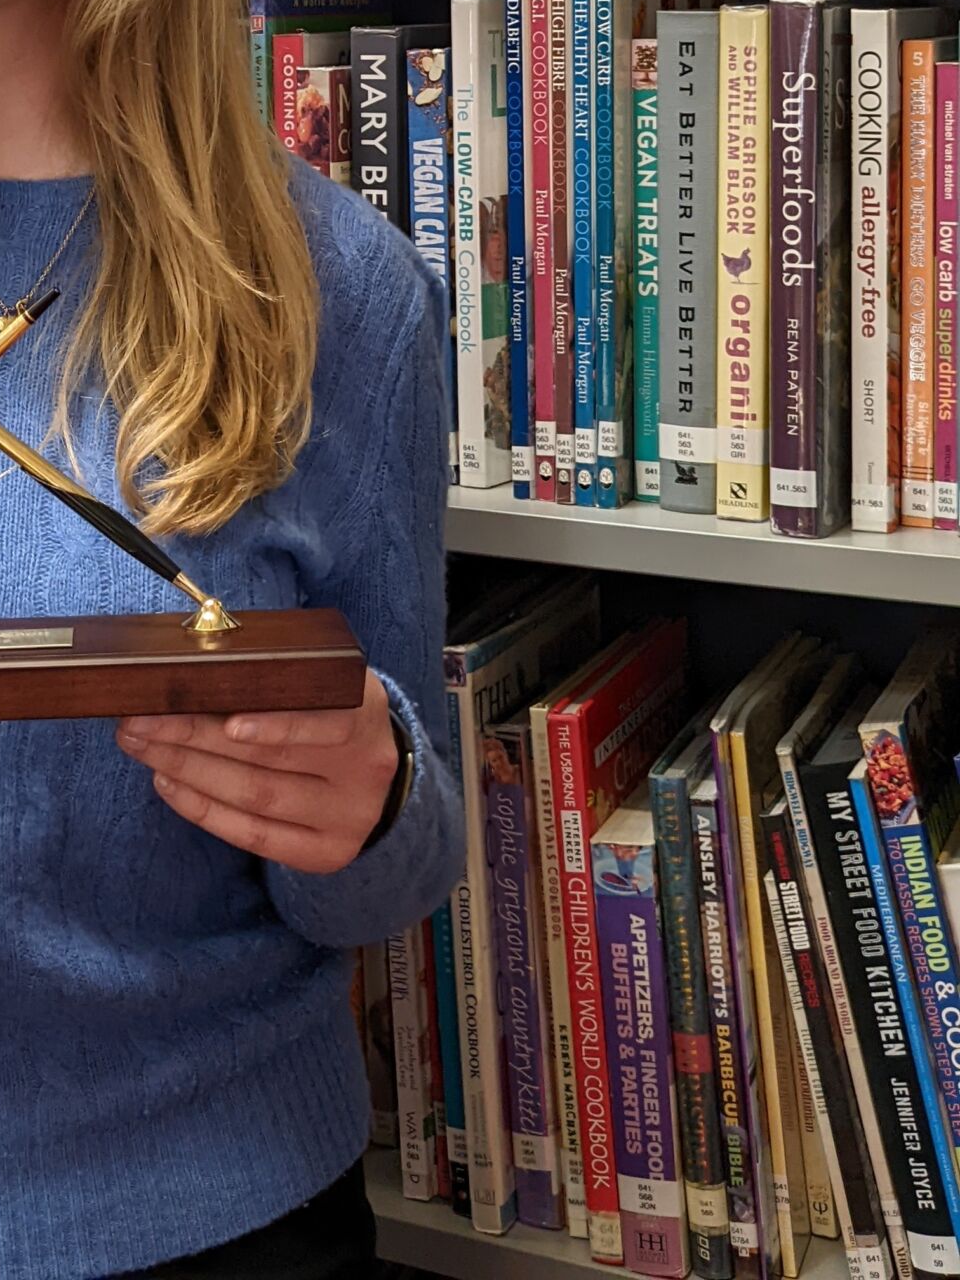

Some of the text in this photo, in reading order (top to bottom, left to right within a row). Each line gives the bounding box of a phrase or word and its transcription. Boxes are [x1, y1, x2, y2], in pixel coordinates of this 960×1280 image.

[508, 81, 523, 195] COOKBOOK
[533, 31, 547, 145] COOKBOOK
[456, 85, 478, 353] The LOW-CARB Cookbook
[535, 190, 548, 220] Paul
[636, 96, 658, 296] VEGAN TREATS
[771, 71, 815, 287] Superfoods
[858, 50, 883, 339] COOKING allergy-free
[512, 256, 524, 286] Paul
[533, 223, 548, 276] Morgan
[935, 100, 957, 421] michael van straten low carb superdrinks
[509, 289, 524, 342] Morgan
[727, 294, 757, 425] organi
[557, 725, 575, 807] THE USBORNE
[827, 791, 905, 1056] MY STREET FOOD KITCHEN
[872, 863, 906, 982] MEDITERRANEAN
[901, 835, 934, 908] INDIAN
[458, 887, 475, 990] CHOLESTEROL
[493, 793, 538, 1070] sophie grigson's country
[917, 916, 948, 972] FOOD
[466, 994, 481, 1079] COOKBOOK
[567, 878, 610, 1189] CHILDREN'S WORLD COOKBOOK
[697, 815, 745, 1186] AINSLEY HARRIOTT'S BARBECUE BIBLE
